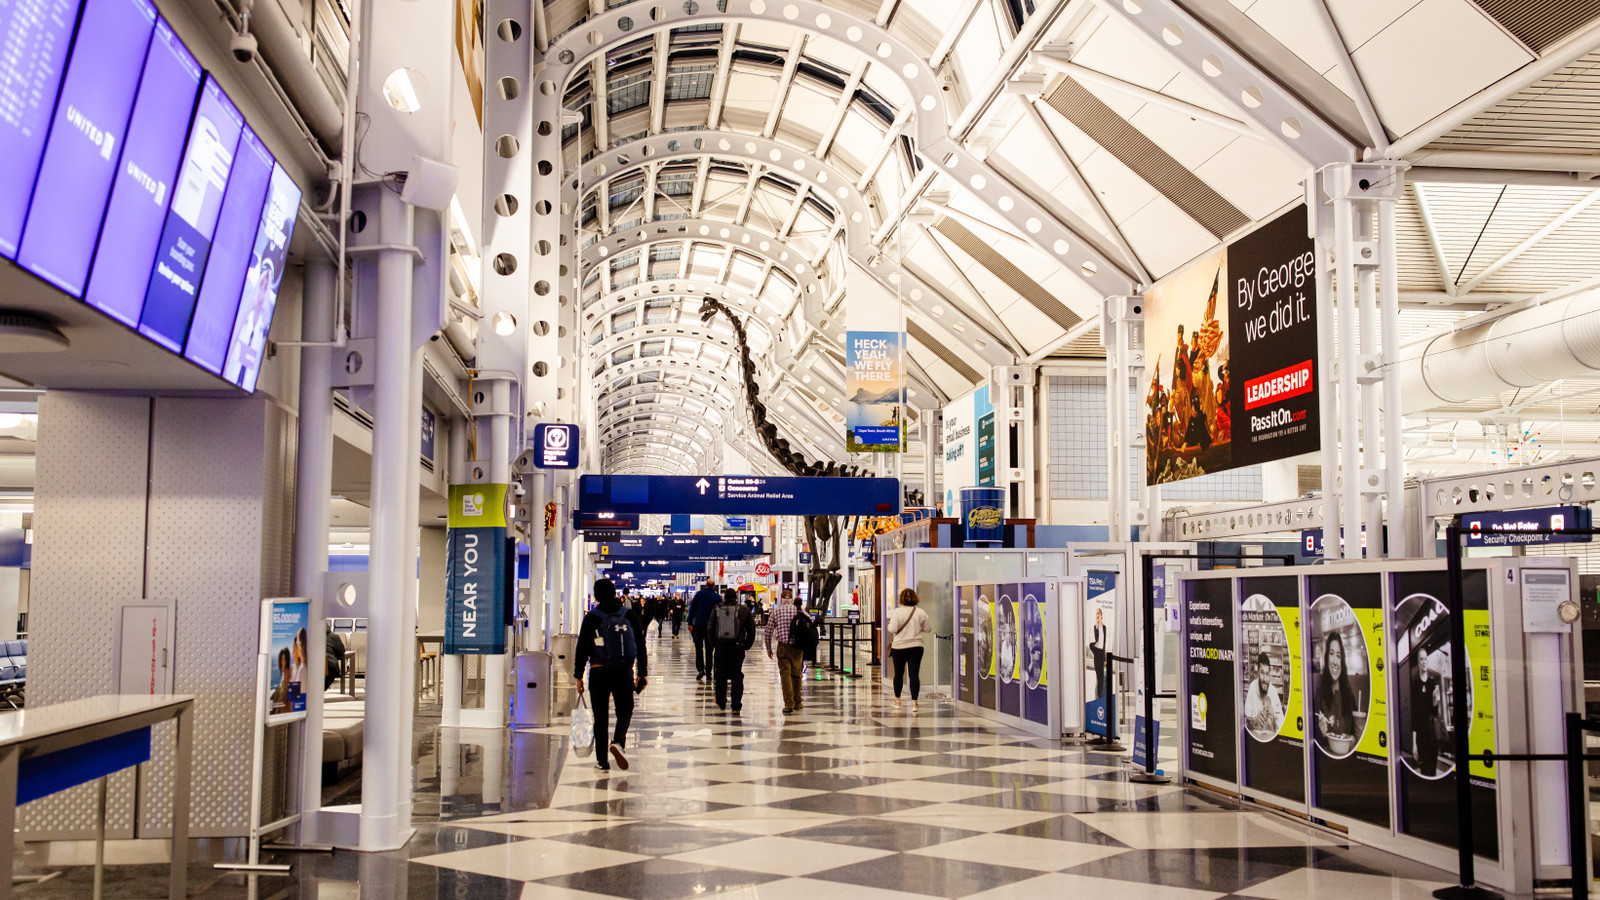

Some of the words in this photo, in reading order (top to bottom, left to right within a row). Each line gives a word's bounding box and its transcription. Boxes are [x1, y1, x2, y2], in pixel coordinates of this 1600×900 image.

[67, 104, 103, 146] UNITED
[127, 160, 157, 193] UNITED
[1238, 277, 1255, 310] By
[1245, 315, 1266, 343] we
[1269, 295, 1292, 333] did
[1296, 292, 1310, 323] it.
[854, 339, 887, 349] HECK
[854, 350, 890, 361] YEAH,
[854, 361, 873, 371] WE
[875, 361, 892, 371] FLY
[854, 371, 894, 382] THERE.
[1247, 368, 1309, 403] LEADERSHIP
[955, 425, 970, 440] business
[1484, 534, 1508, 545] Security
[1509, 533, 1544, 544] Checkpoint
[464, 534, 479, 578] YOU
[1507, 569, 1513, 582] 4
[463, 582, 478, 637] NEAR
[1189, 601, 1210, 612] Experience
[1202, 616, 1224, 628] interesting,
